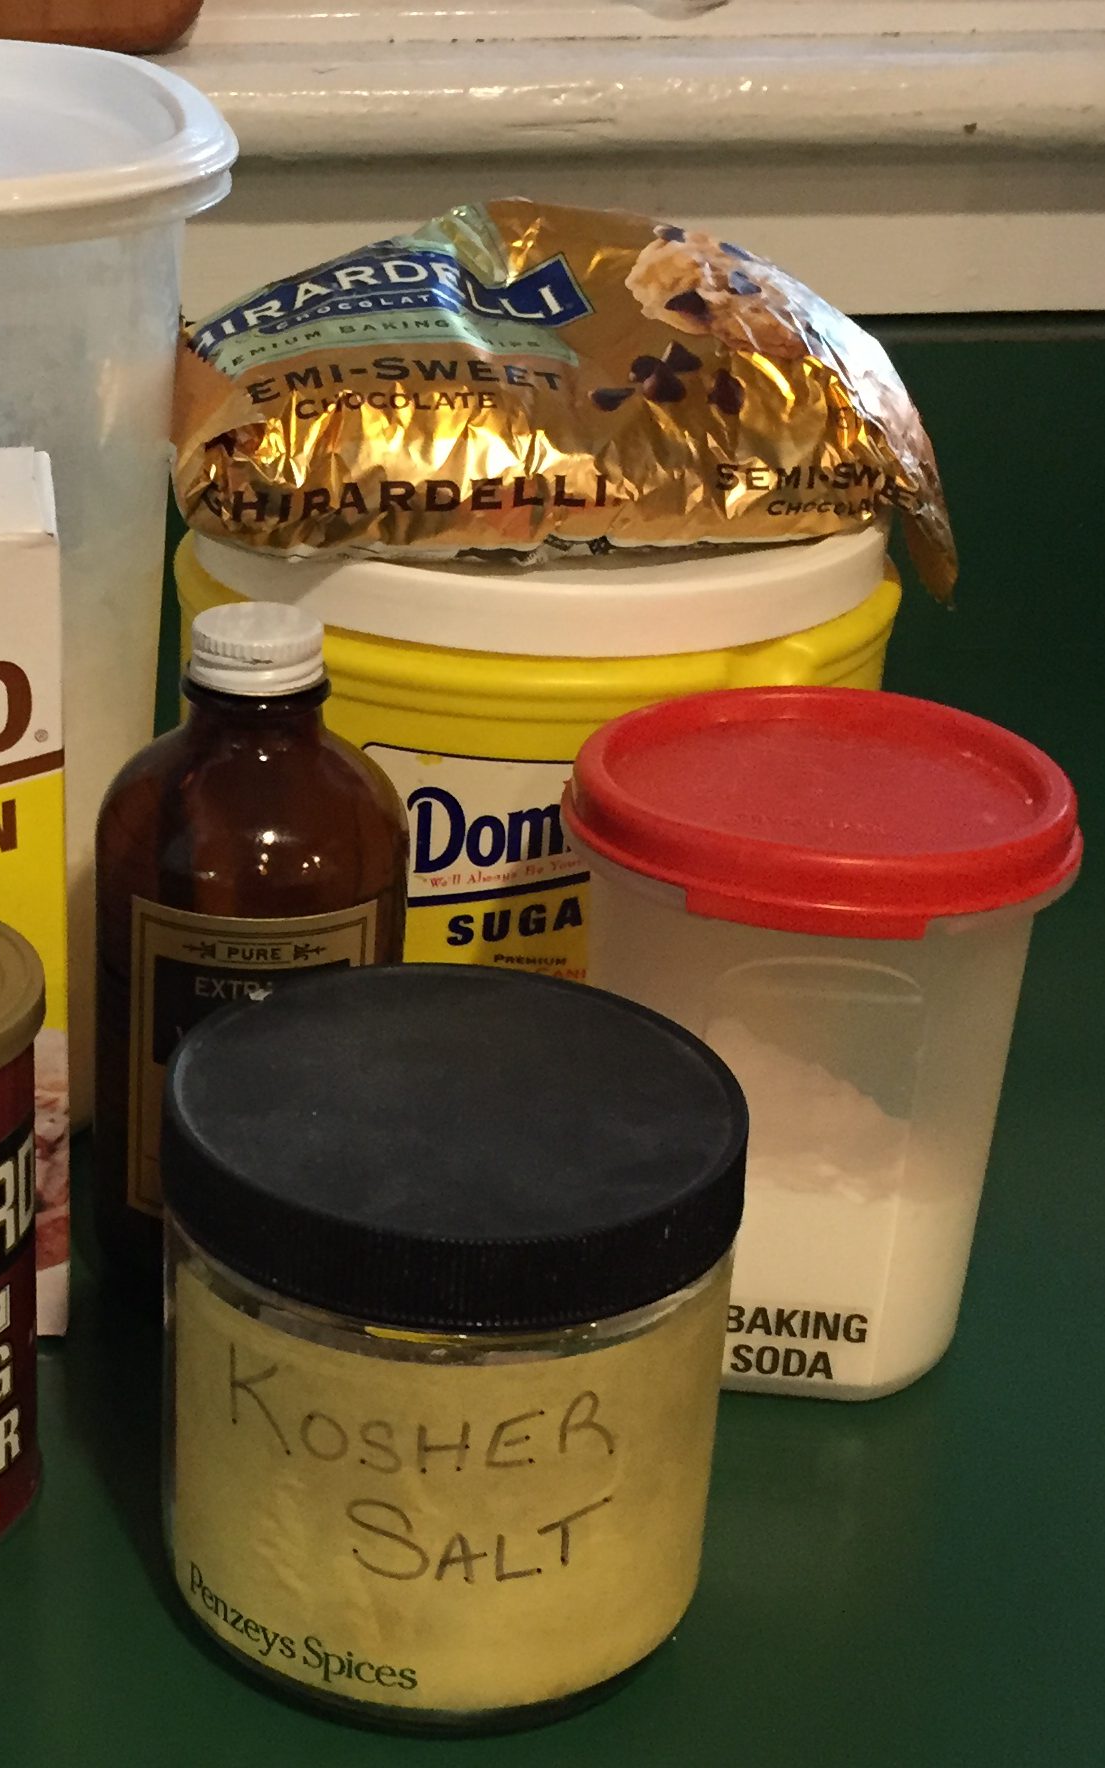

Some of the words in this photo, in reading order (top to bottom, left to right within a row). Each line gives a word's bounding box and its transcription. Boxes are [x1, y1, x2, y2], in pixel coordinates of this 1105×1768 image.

[196, 258, 566, 352] HIRARDELLI
[275, 292, 441, 331] CHOCOLAT
[338, 318, 451, 336] BAKING
[246, 355, 563, 406] EMI-SWEET
[295, 389, 499, 422] CHOCOLATE
[406, 786, 572, 873] Dom
[446, 896, 583, 946] SUGA
[227, 946, 283, 961] PURE
[493, 954, 568, 966] PREMIUM
[726, 1304, 869, 1344] BAKING
[730, 1344, 834, 1380] SODA
[229, 1342, 617, 1474] KOSHER
[346, 1494, 614, 1584] SALT
[189, 1560, 297, 1660] Penzeys
[302, 1635, 418, 1691] Spices
